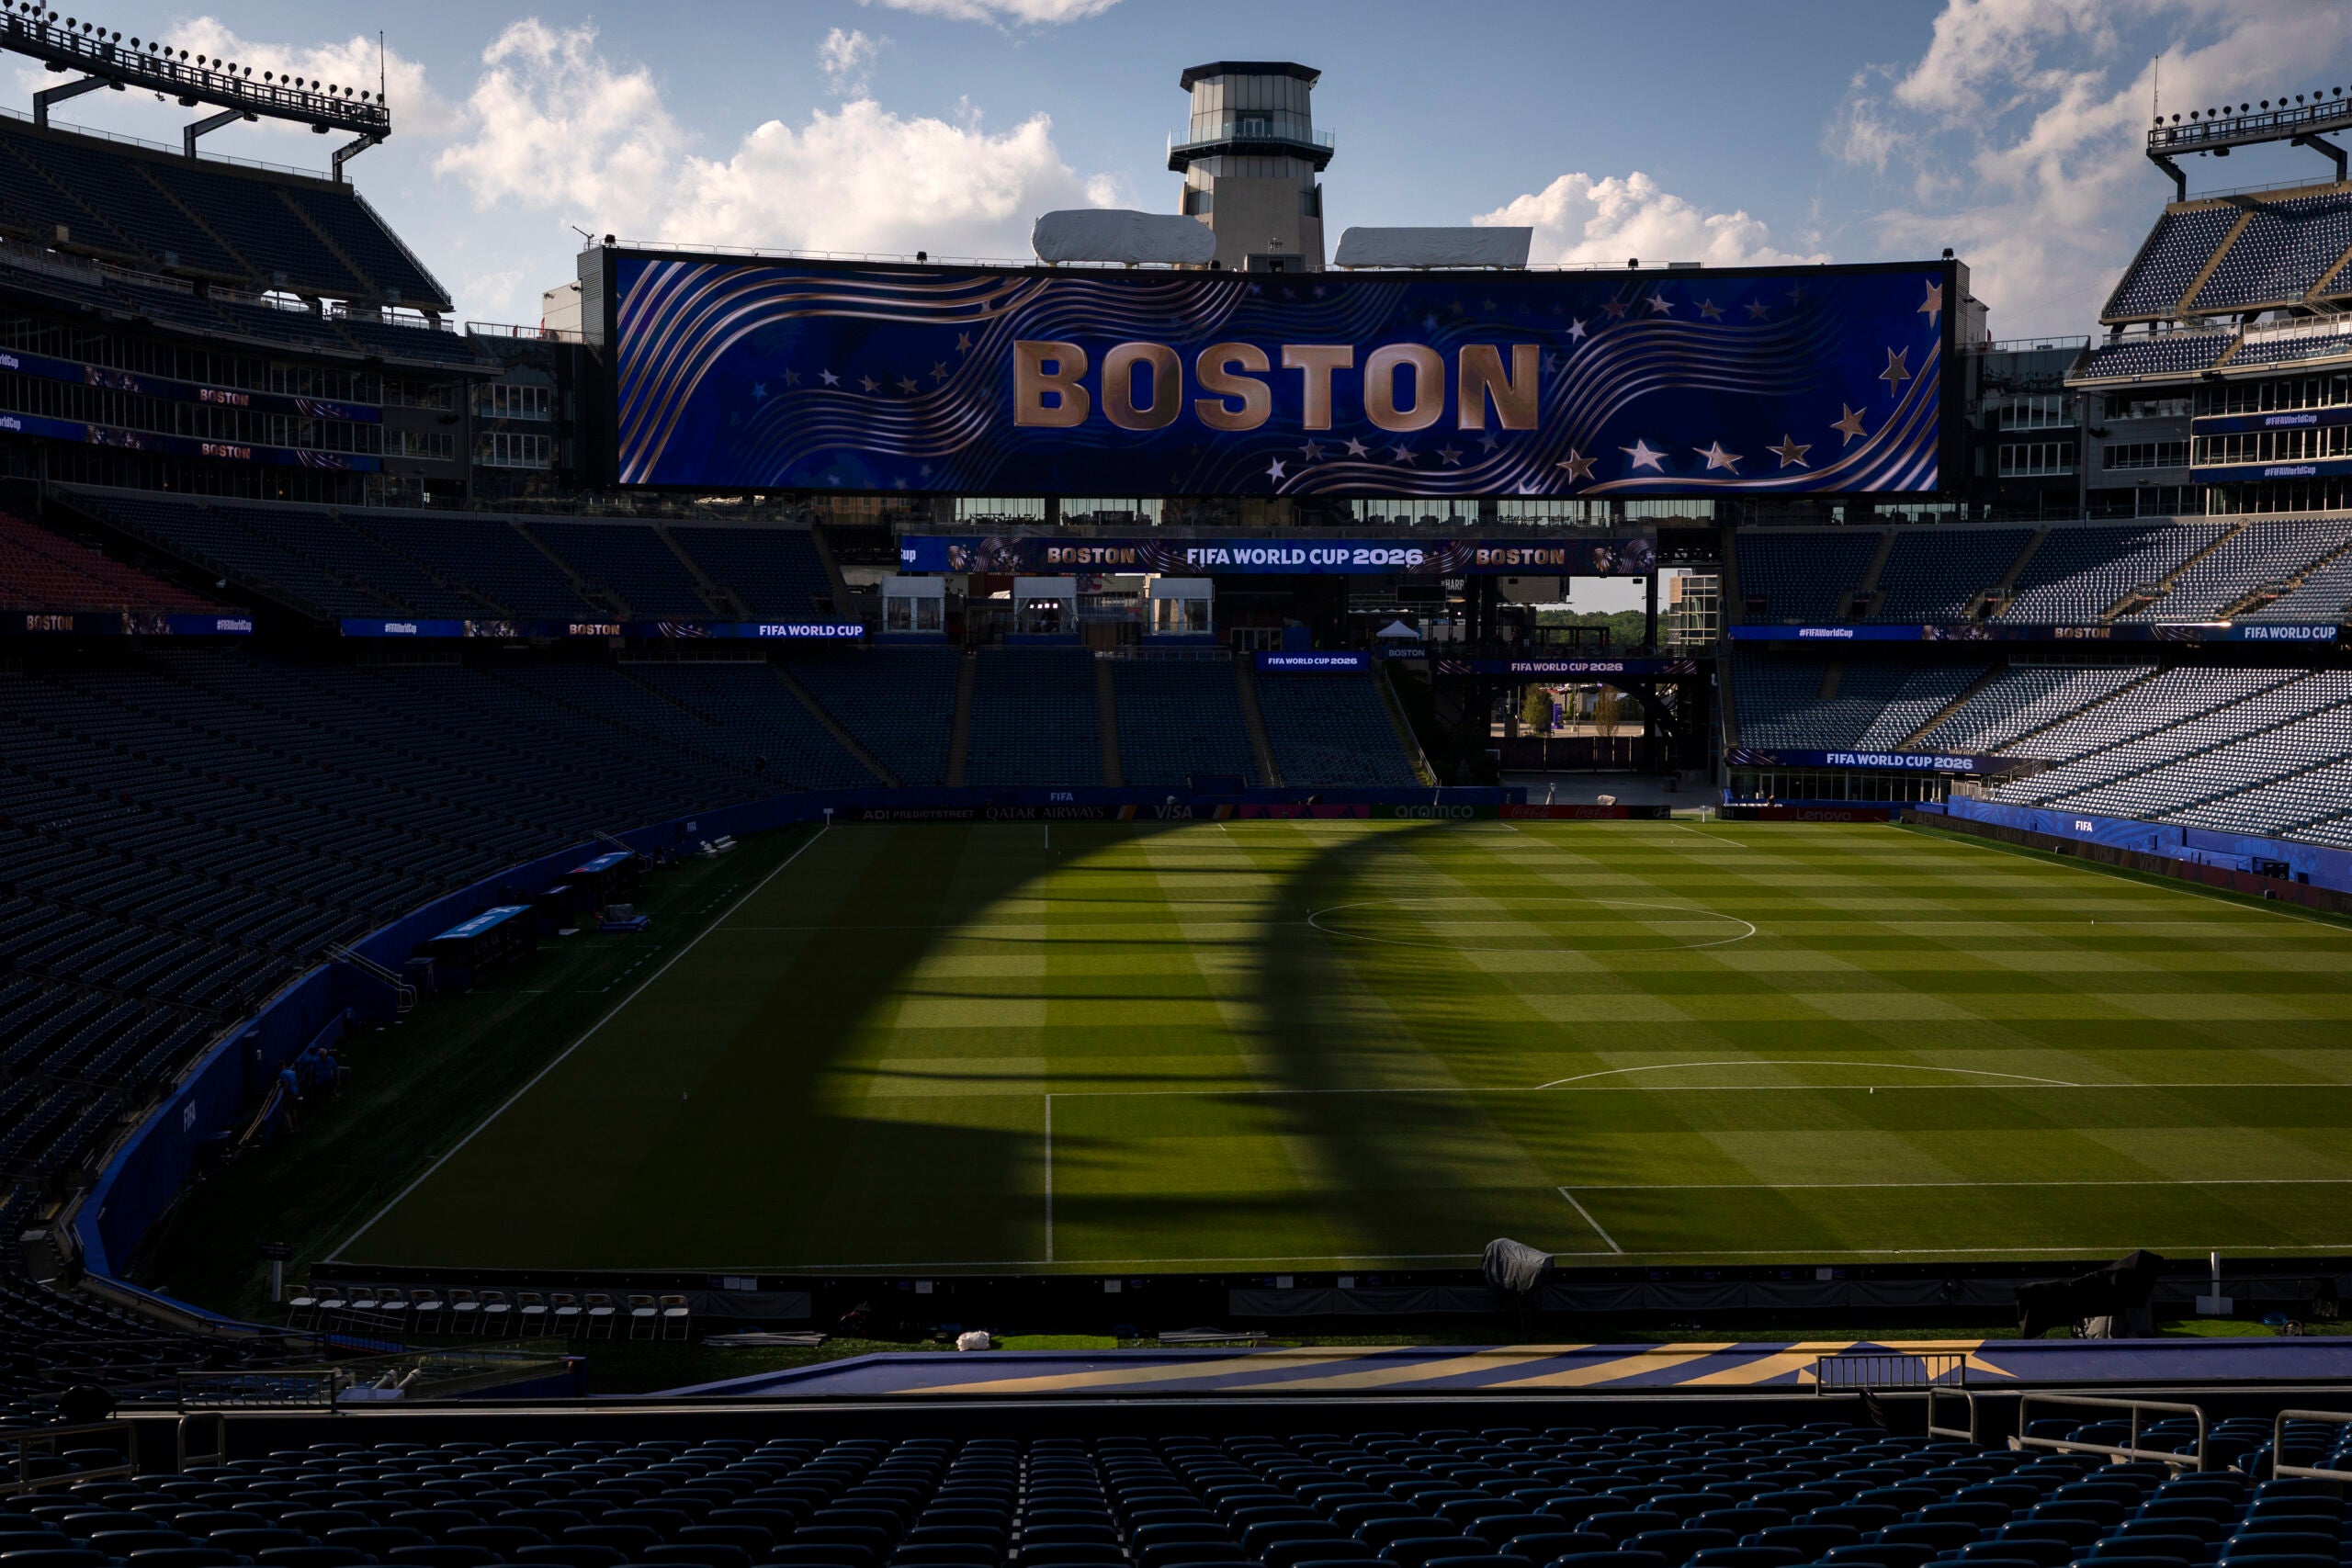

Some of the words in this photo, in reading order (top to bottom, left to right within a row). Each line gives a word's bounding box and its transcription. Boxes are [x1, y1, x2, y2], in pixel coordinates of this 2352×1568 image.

[1013, 341, 1540, 433] BOSTON
[199, 389, 249, 406] BOSTON
[2265, 414, 2317, 425] #FIFAWorldCup
[201, 443, 251, 459] BOSTON
[2265, 466, 2316, 477] #FIFAWorldCup
[901, 548, 917, 563] up
[1047, 547, 1135, 564] BOSTON
[1187, 548, 1230, 564] FIFA
[1234, 548, 1306, 565] WORLD
[1309, 548, 1350, 565] CUP
[1353, 549, 1424, 565] 2026
[1476, 548, 1565, 565] BOSTON
[26, 615, 74, 632] BOSTON
[569, 624, 620, 636] BOSTON
[759, 625, 786, 636] FIFA
[788, 625, 835, 636] WORLD
[837, 625, 864, 636] CUP
[1799, 628, 1853, 639] #FIFAWorldCup
[2054, 626, 2110, 639] BOSTON
[2245, 626, 2268, 638] FIFA
[2269, 626, 2311, 638] WORLD
[2312, 626, 2335, 638] CUP
[1511, 662, 1532, 671] FIFA
[1532, 662, 1567, 671] WORLD
[1569, 662, 1589, 671] CUP
[1589, 662, 1623, 671] 2026
[1826, 752, 1852, 766] FIFA
[1854, 753, 1902, 768] WORLD
[1905, 755, 1931, 769] CUP
[1934, 757, 1973, 770] 2026
[1050, 793, 1073, 801] FIFA
[864, 809, 889, 819] ADI
[893, 809, 974, 818] PREDICTSTREET
[986, 807, 1035, 821] QATAR
[1043, 807, 1103, 818] AIRWAYS
[1154, 805, 1193, 819] VISA
[1396, 805, 1475, 818] aramco
[1796, 808, 1852, 821] Lenovo
[2075, 820, 2093, 832] FIFA
